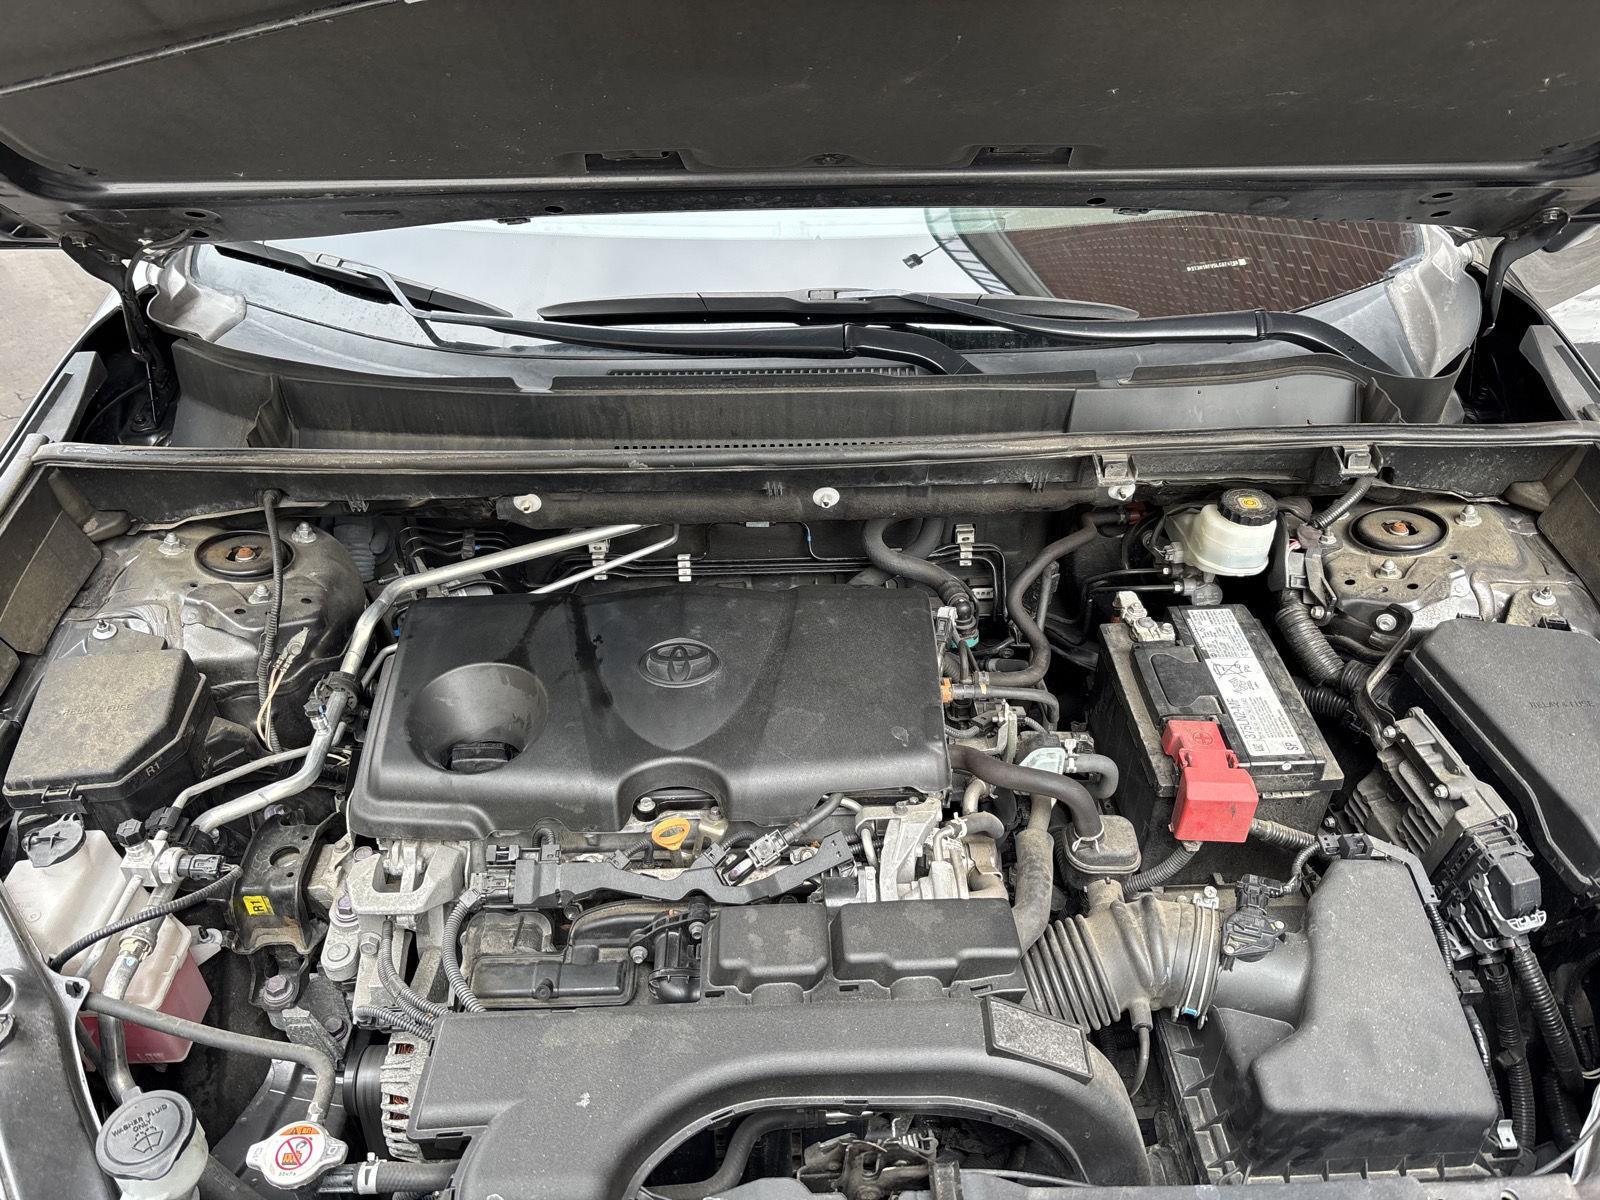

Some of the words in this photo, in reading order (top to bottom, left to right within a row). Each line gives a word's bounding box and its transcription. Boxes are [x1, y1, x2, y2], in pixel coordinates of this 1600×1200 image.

[106, 704, 133, 713] FUSE
[1227, 698, 1257, 740] 375LN2-MF
[1284, 742, 1299, 751] SP
[145, 762, 161, 777] R1
[250, 900, 265, 912] R1
[111, 1116, 144, 1138] WASHER
[147, 1103, 168, 1118] FLUID
[132, 1118, 152, 1133] ONLY
